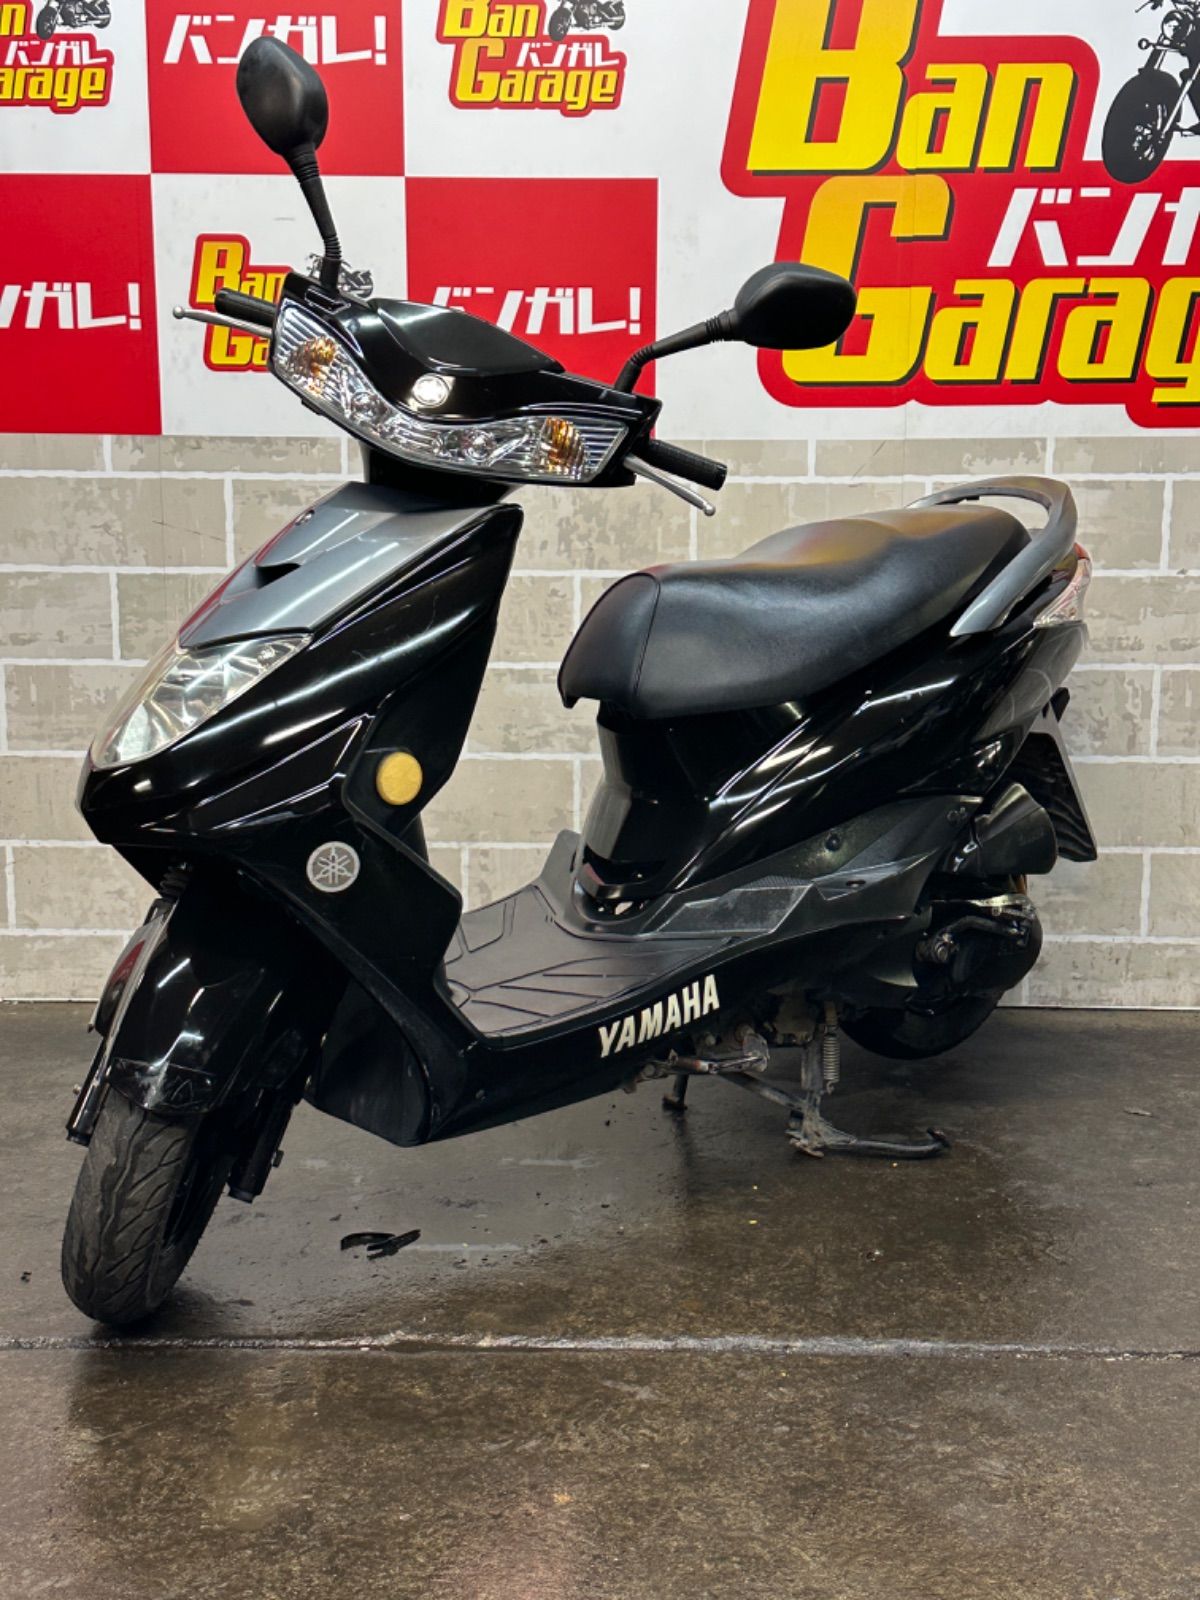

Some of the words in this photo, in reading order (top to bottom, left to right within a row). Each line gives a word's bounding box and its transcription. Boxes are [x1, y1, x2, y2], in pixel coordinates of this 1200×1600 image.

[4, 41, 108, 66] バンガレ
[455, 38, 618, 110] Garage
[516, 42, 620, 68] バンガレ
[747, 0, 1076, 172] Ban
[598, 974, 721, 1058] YAMAHA
